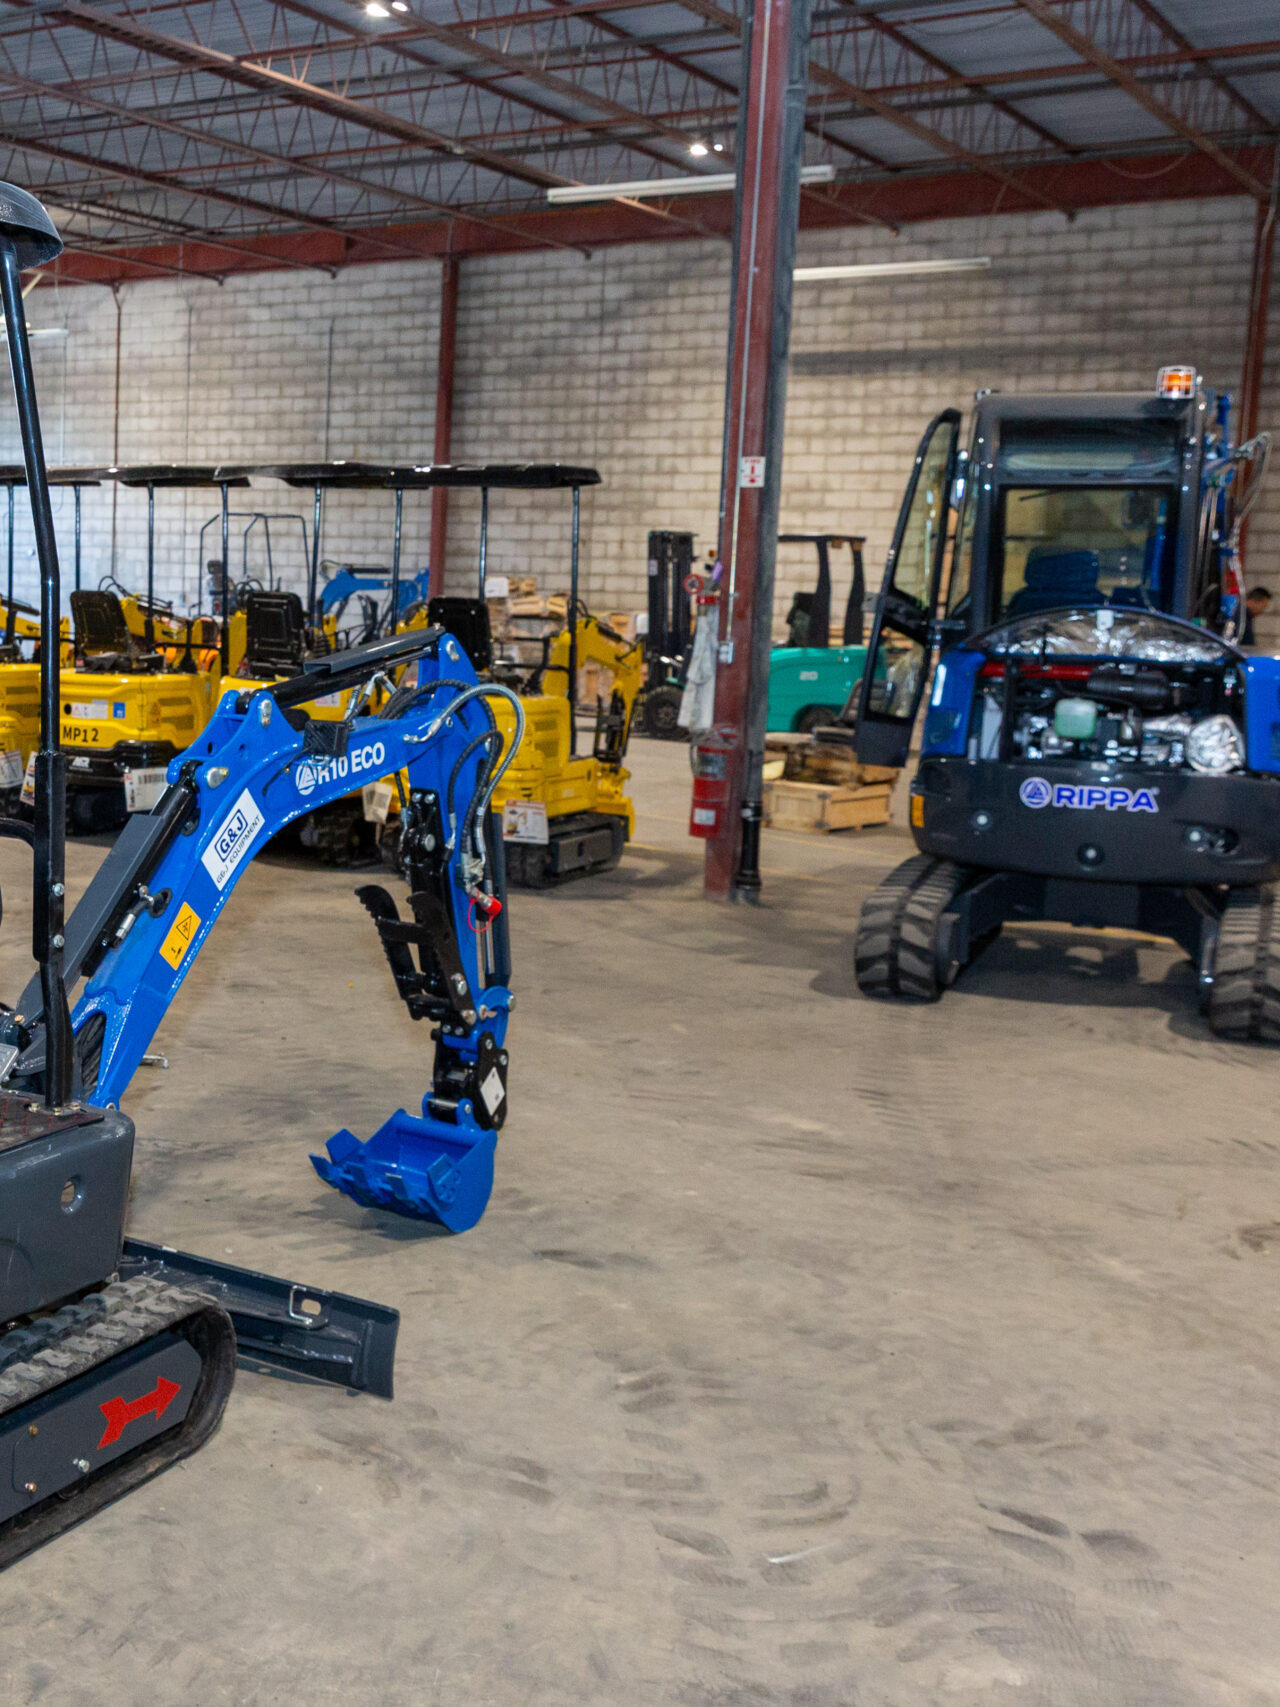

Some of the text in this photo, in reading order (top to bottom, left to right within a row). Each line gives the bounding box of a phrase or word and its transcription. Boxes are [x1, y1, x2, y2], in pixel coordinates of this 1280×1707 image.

[62, 725, 99, 743] MP12
[351, 742, 385, 774] ECO
[220, 816, 243, 854] G&J
[229, 814, 261, 863] EQUIPMENT
